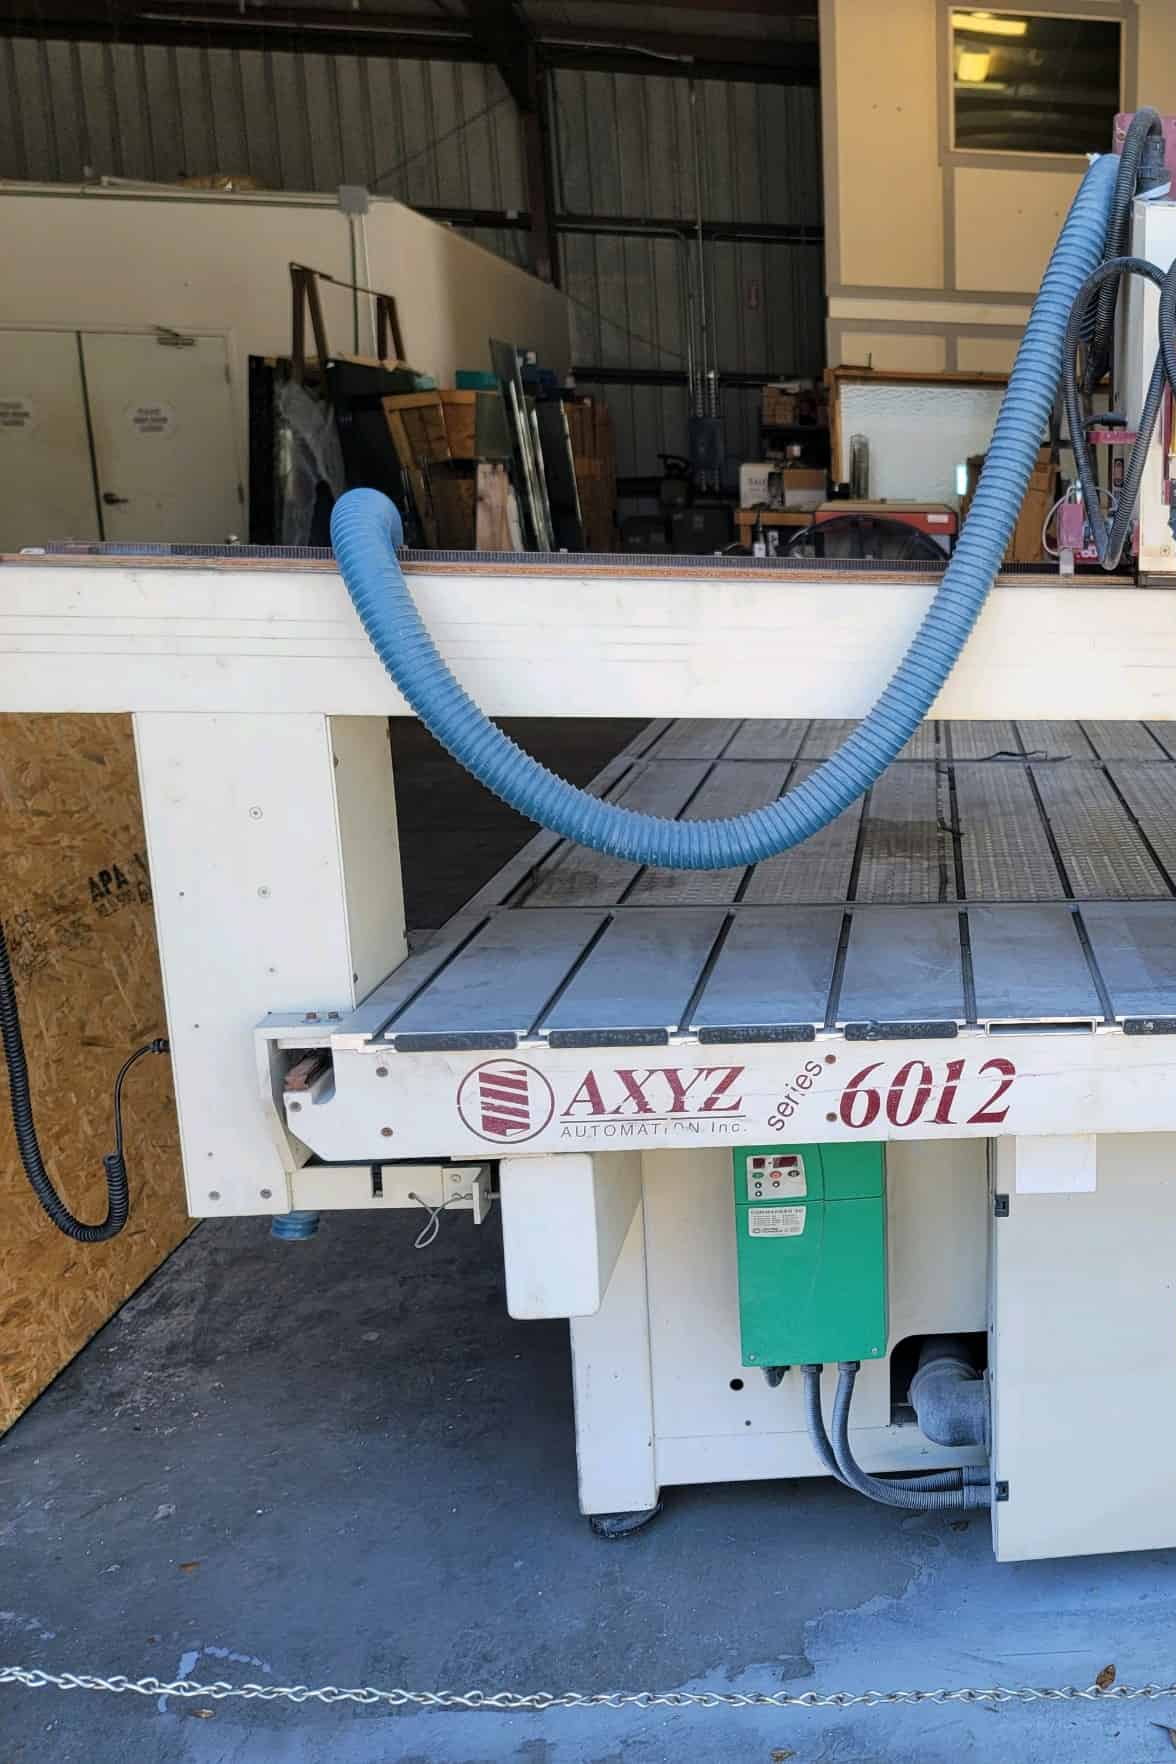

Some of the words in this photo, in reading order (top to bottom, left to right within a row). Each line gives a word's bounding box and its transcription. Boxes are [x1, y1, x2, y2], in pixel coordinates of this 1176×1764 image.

[88, 863, 129, 903] APA
[560, 1066, 746, 1117] AXYZ
[767, 1060, 823, 1132] series
[839, 1057, 1017, 1129] 6012
[711, 1121, 748, 1134] Inc.
